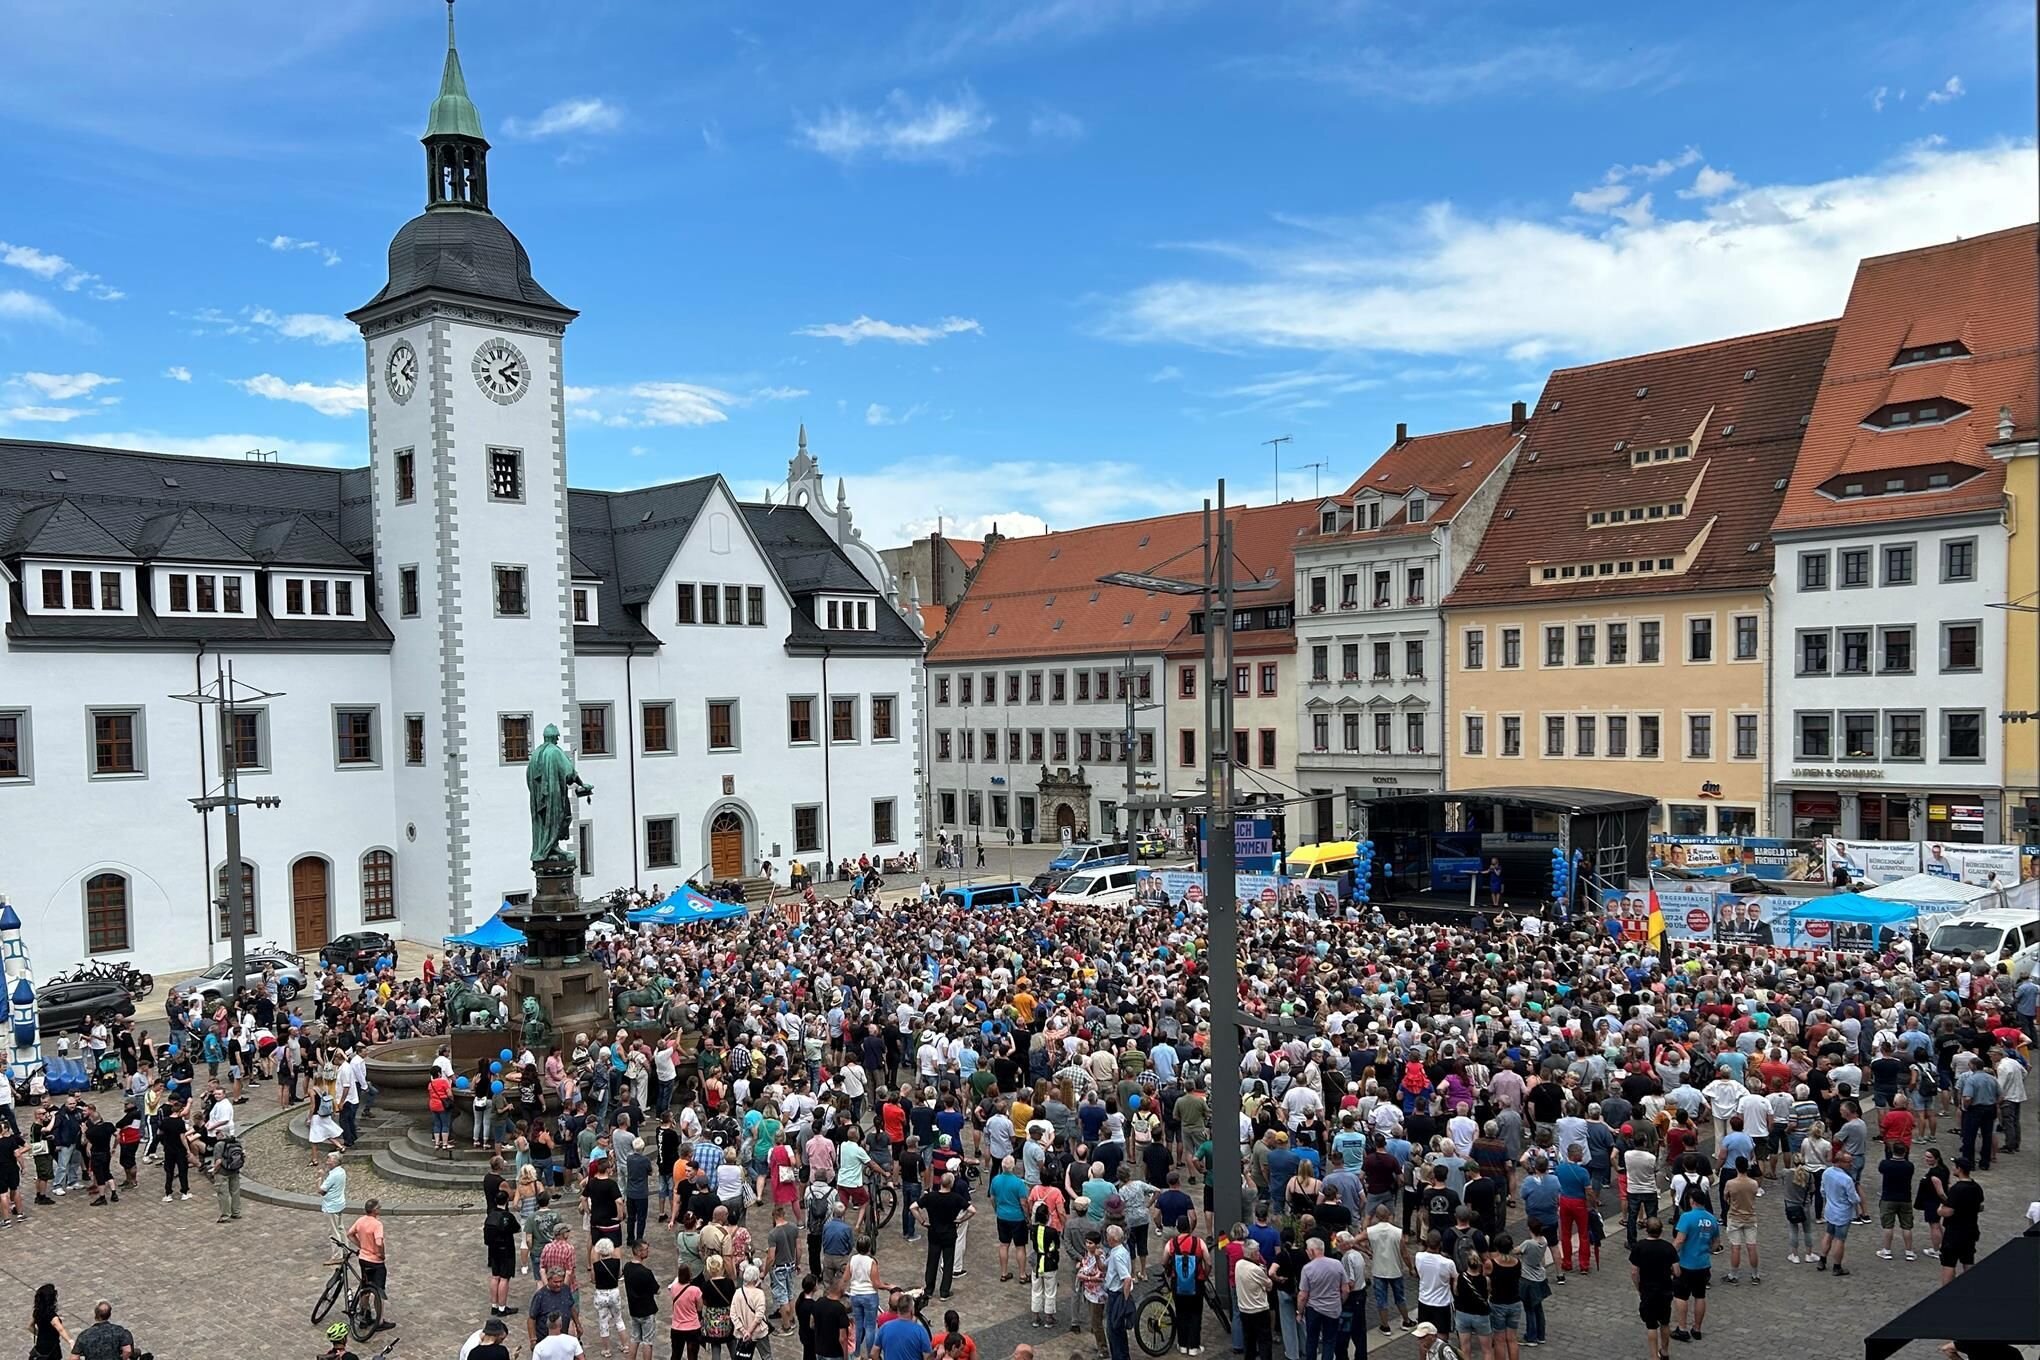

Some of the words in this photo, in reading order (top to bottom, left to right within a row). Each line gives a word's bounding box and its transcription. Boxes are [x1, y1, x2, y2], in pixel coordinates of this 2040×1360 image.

[1834, 769, 1885, 779] SCHMUCK
[1702, 780, 1720, 792] dm
[1235, 841, 1268, 855] OMMEN
[1754, 847, 1785, 856] BARGELD
[1786, 848, 1798, 857] IST
[1688, 853, 1719, 861] Zielinski
[1754, 857, 1787, 865] FREIHEIT!
[1659, 894, 1709, 902] ÜRGERDIALOG
